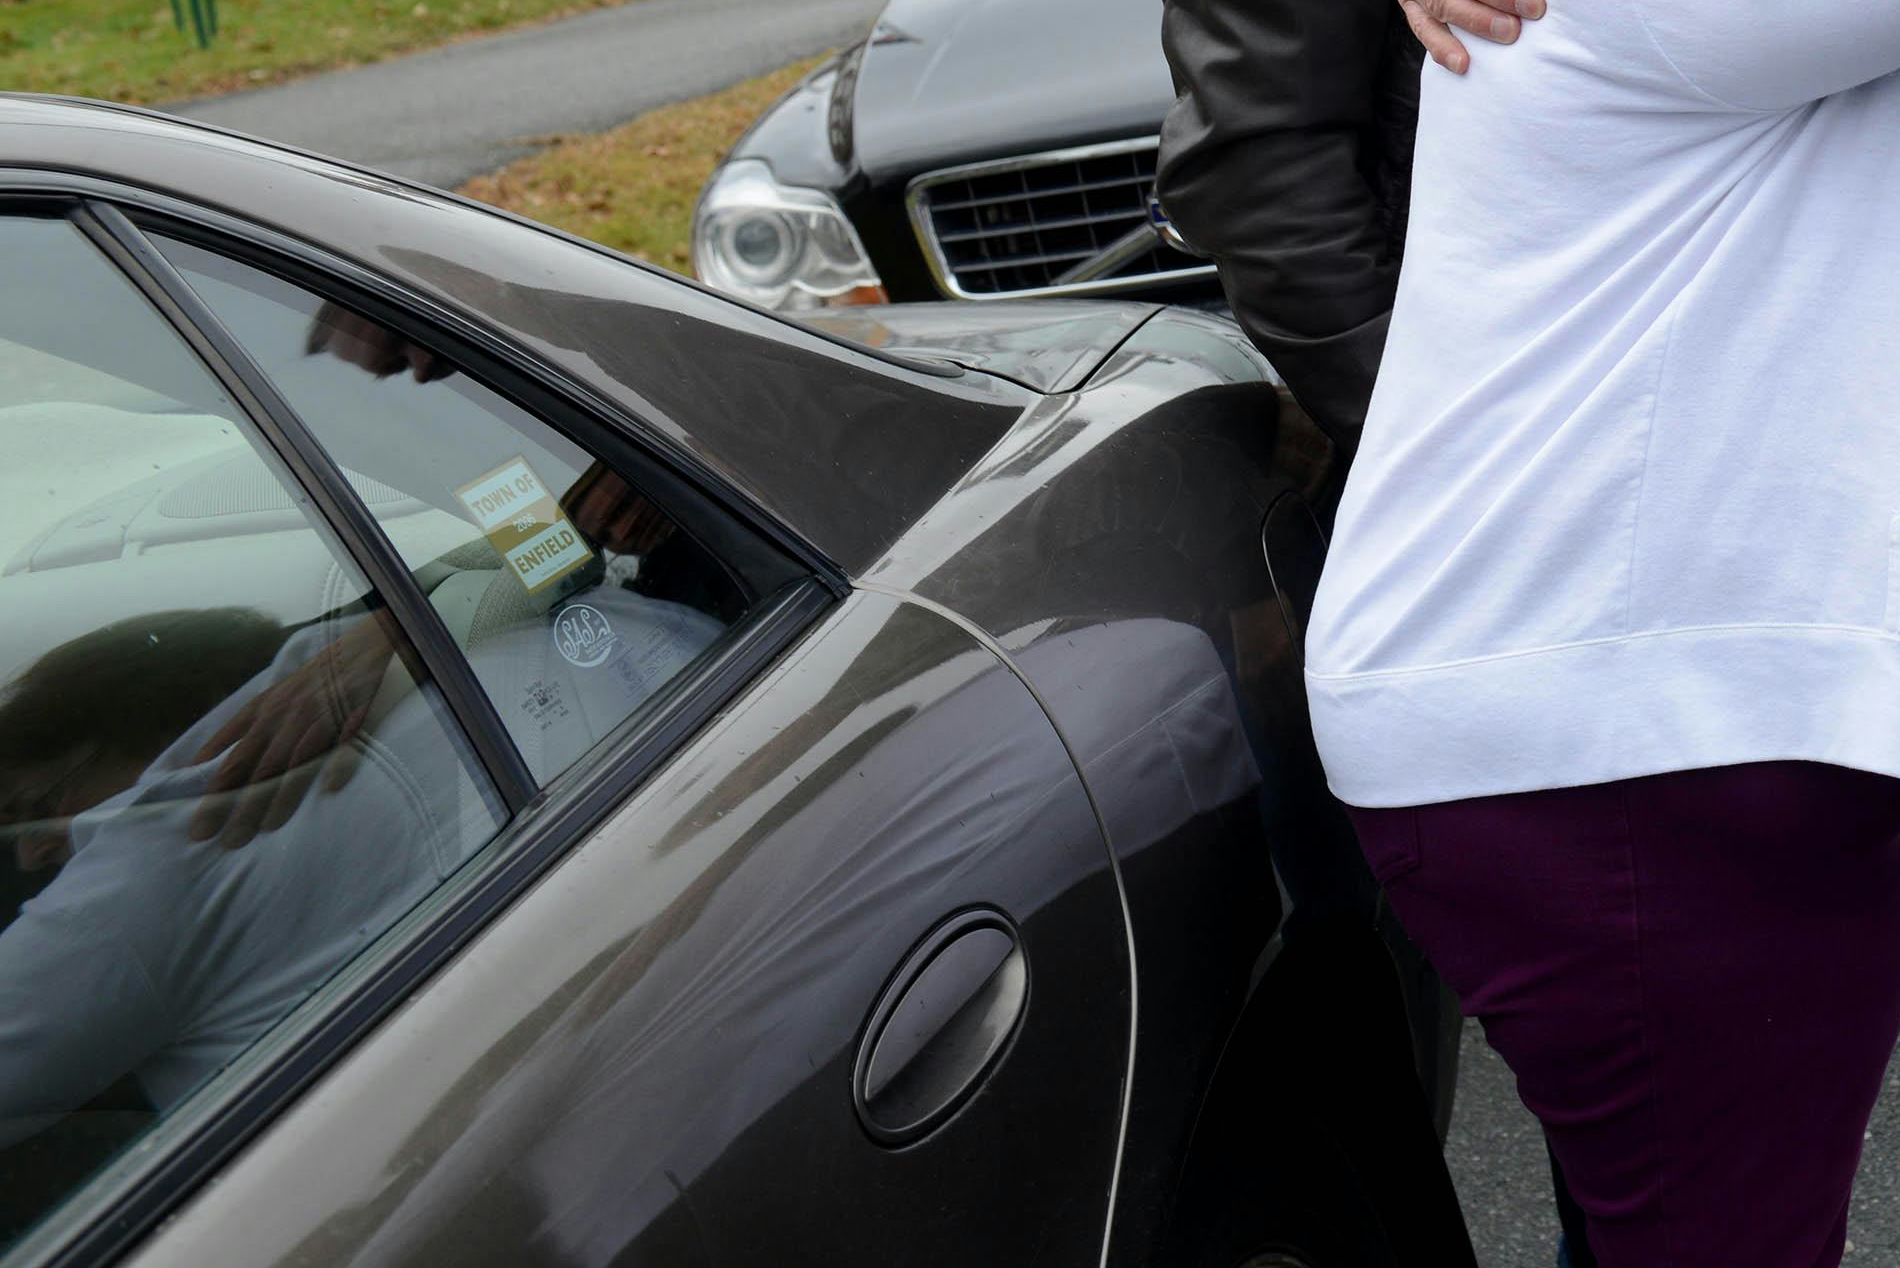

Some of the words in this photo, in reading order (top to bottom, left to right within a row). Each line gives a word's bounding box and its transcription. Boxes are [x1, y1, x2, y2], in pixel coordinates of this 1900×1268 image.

[471, 482, 517, 517] TOWN
[514, 473, 537, 495] OF
[514, 529, 575, 575] ENFIELD
